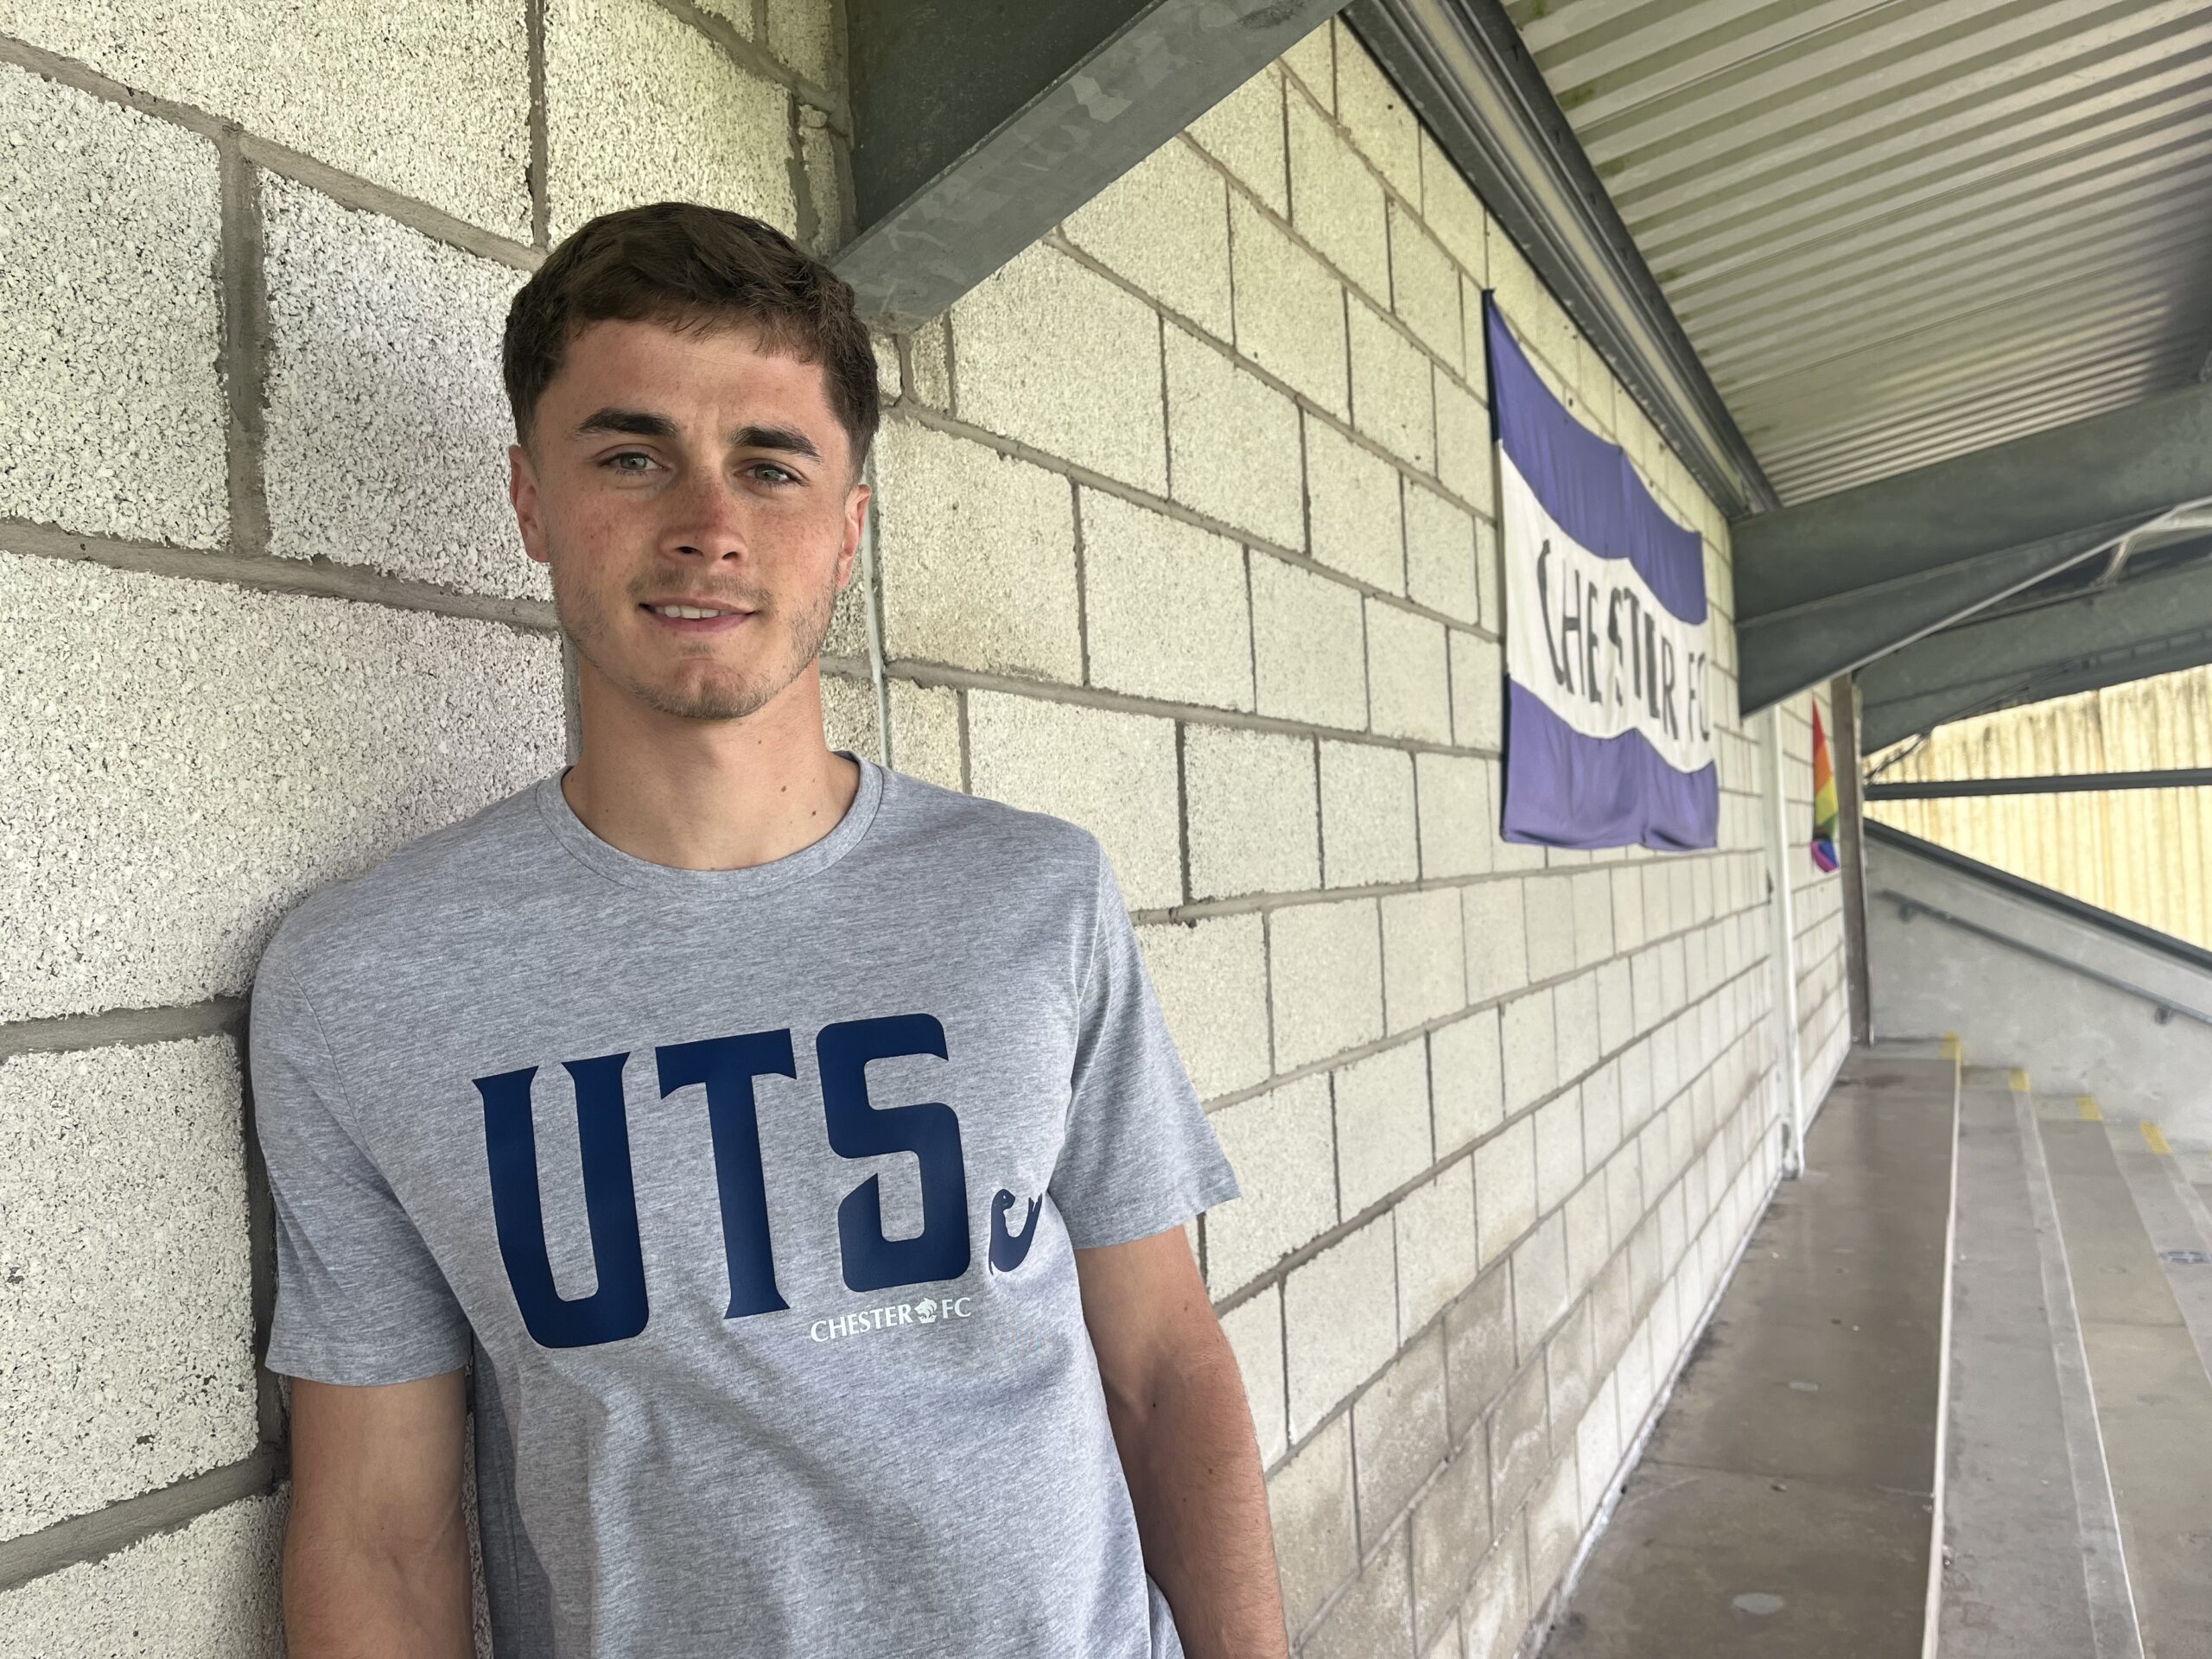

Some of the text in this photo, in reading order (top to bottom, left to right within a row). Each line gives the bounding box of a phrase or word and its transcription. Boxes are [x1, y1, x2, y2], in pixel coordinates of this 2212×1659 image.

[473, 1013, 971, 1349] UTS
[810, 1297, 972, 1343] CHESTER FC
